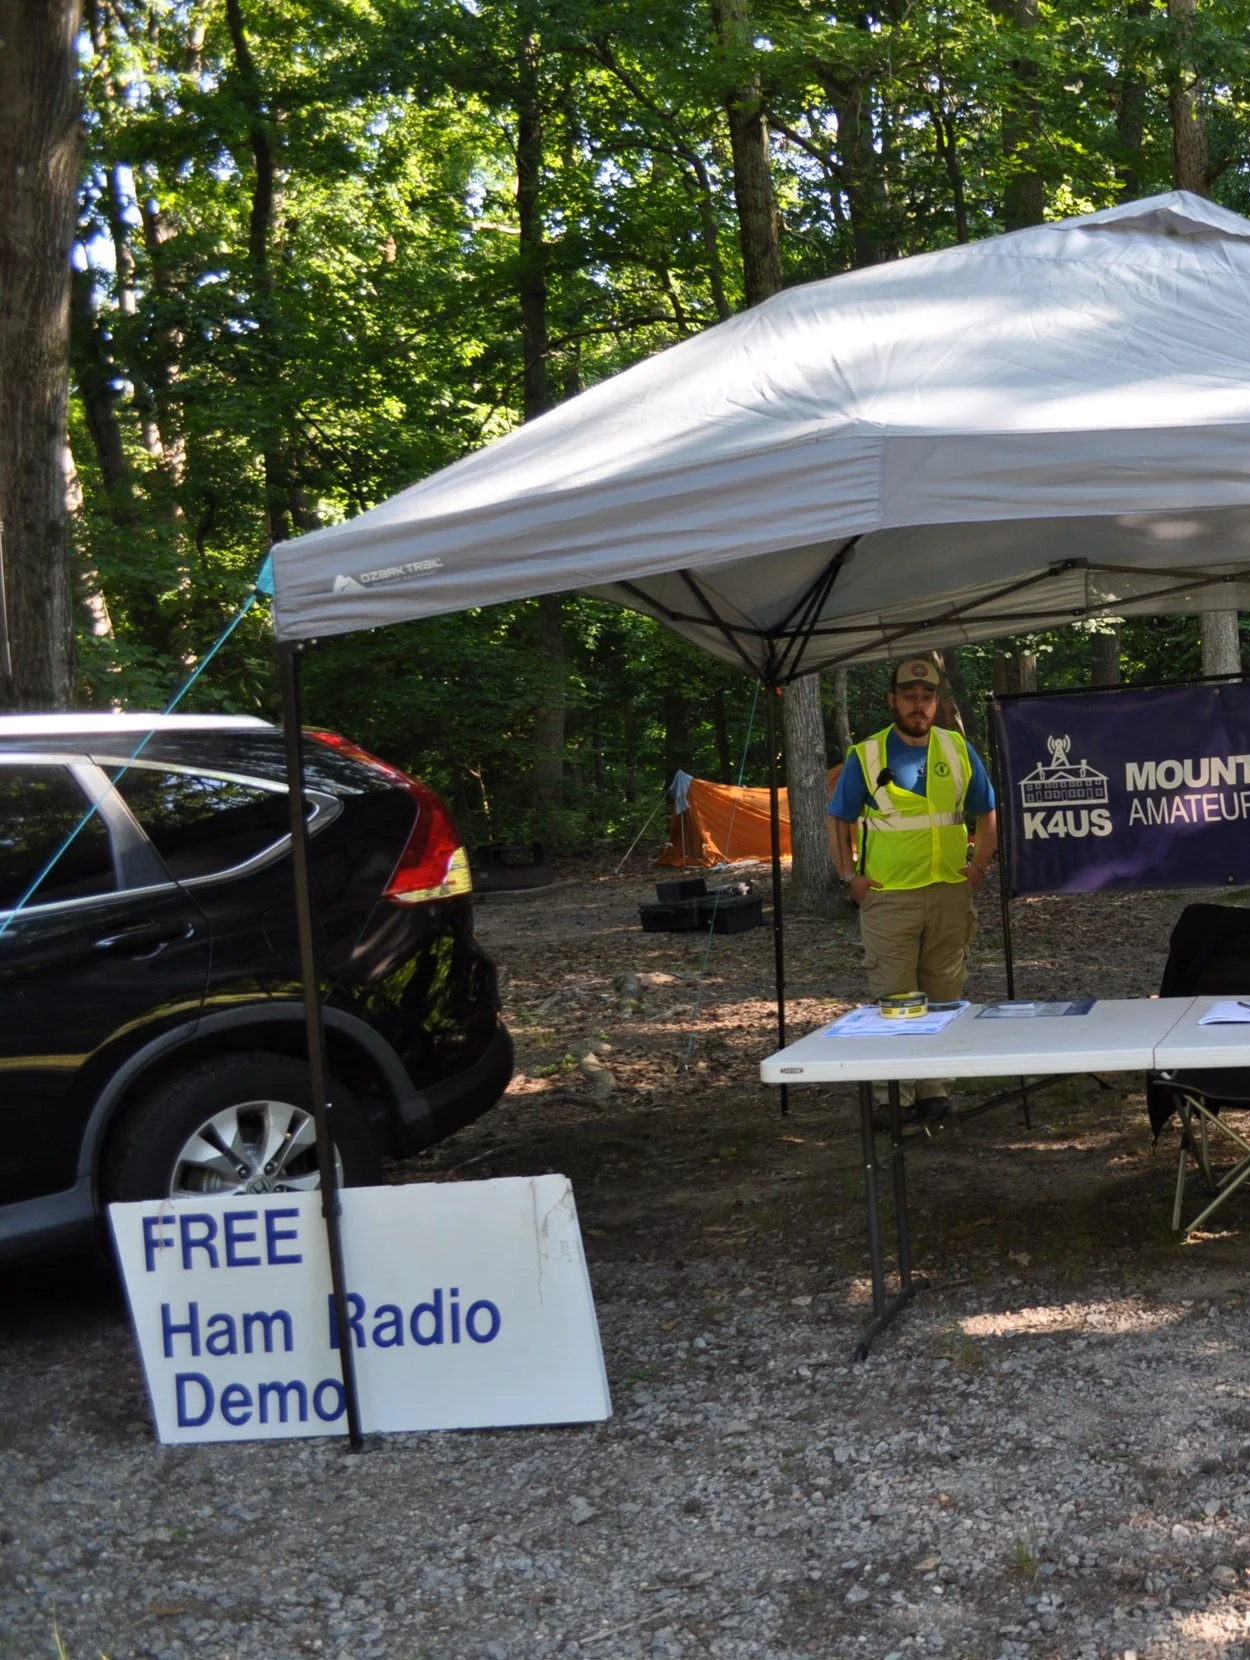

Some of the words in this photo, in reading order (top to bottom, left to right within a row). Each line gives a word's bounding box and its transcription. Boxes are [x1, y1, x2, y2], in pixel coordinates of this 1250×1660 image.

[1022, 807, 1114, 840] K4US
[141, 1207, 303, 1272] FREE
[160, 1301, 294, 1359] Ham
[328, 1287, 502, 1350] Radio
[174, 1371, 347, 1428] Demo
